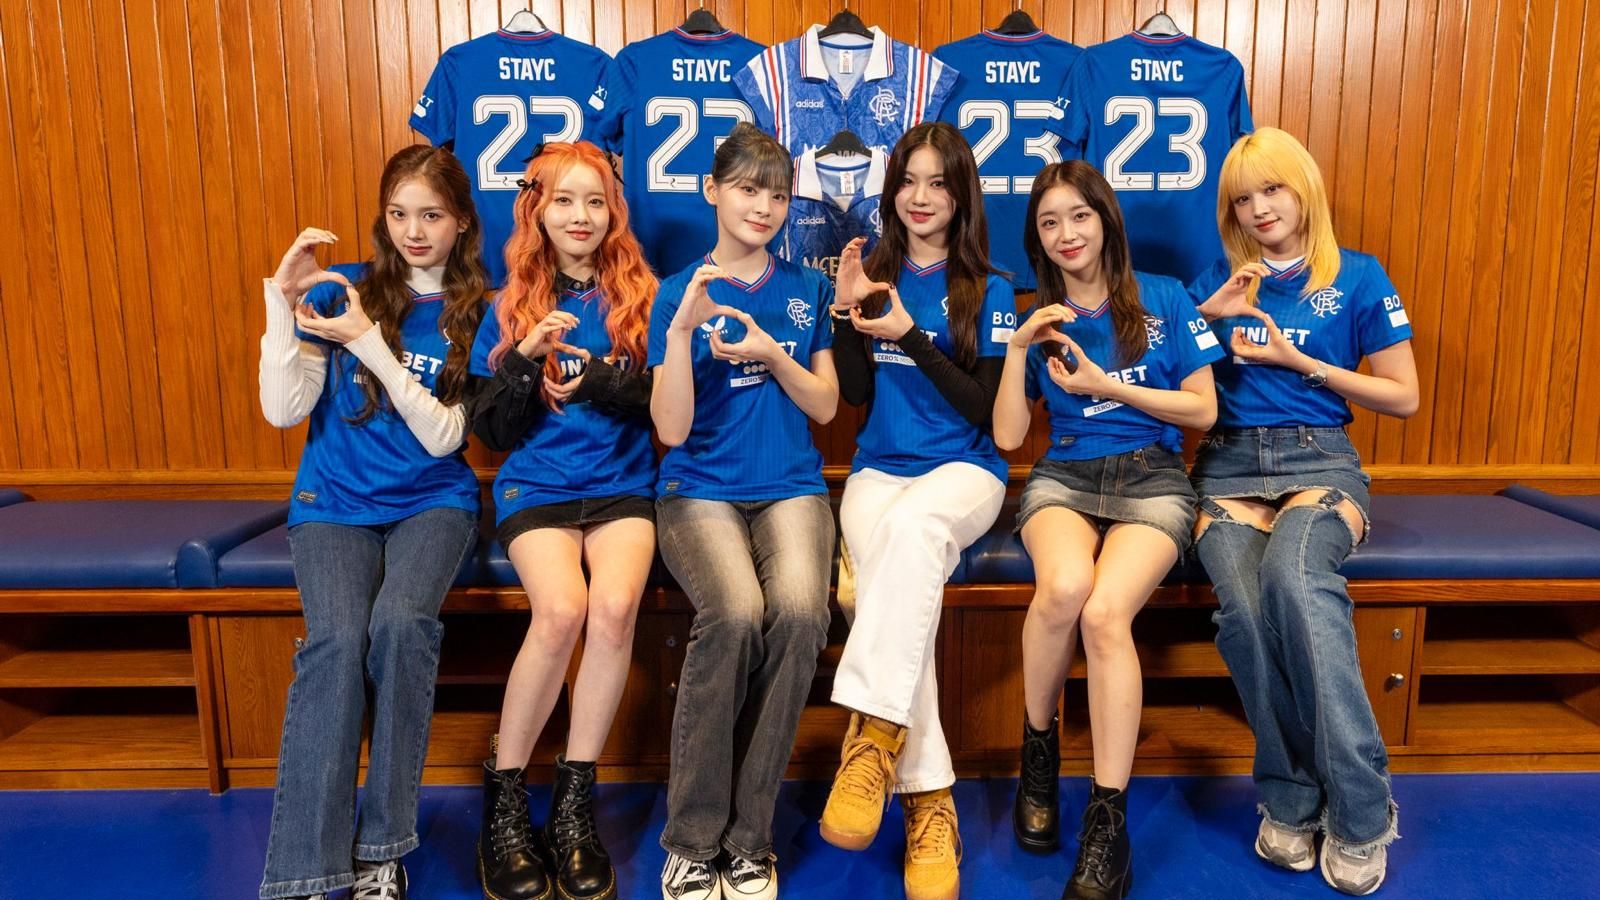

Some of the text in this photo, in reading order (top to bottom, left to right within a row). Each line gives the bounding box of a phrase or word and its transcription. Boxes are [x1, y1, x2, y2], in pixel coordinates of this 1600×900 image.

[499, 57, 556, 81] STAYC
[672, 58, 731, 82] STAYC
[985, 60, 1040, 83] STAYC
[1130, 59, 1184, 82] STAYC
[795, 99, 824, 108] adidas
[1104, 96, 1208, 191] 23
[796, 215, 826, 225] adidas
